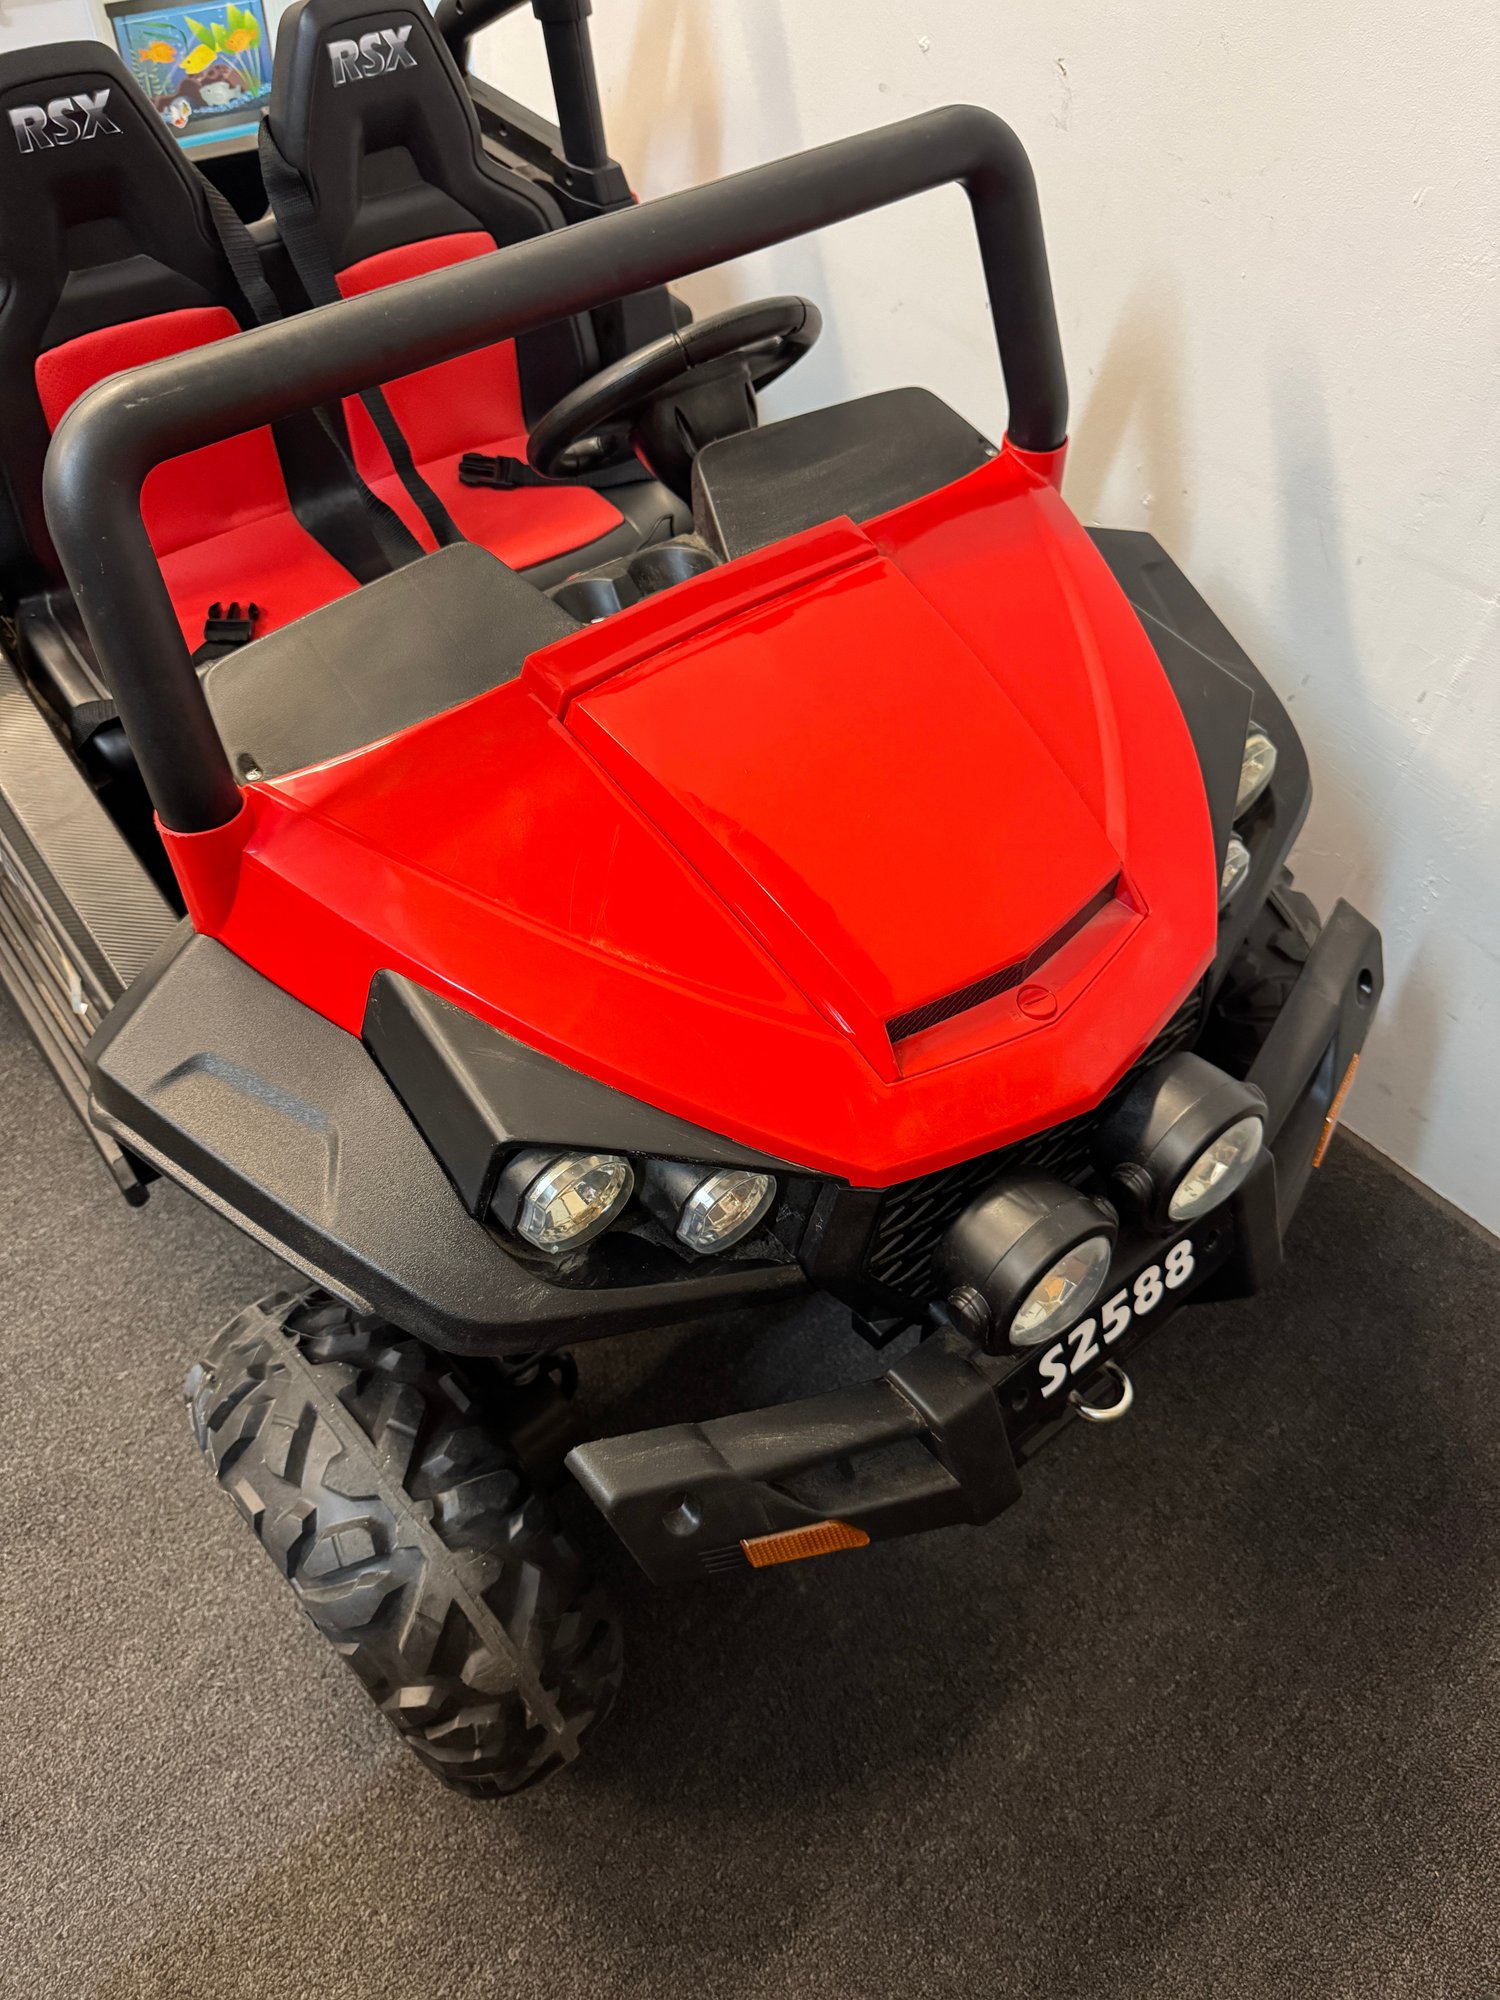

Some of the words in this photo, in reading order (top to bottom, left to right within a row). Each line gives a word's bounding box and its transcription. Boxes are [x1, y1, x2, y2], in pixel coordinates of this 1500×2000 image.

[326, 25, 418, 87] RSX
[8, 88, 121, 154] RSX
[1038, 1239, 1195, 1398] S2588
